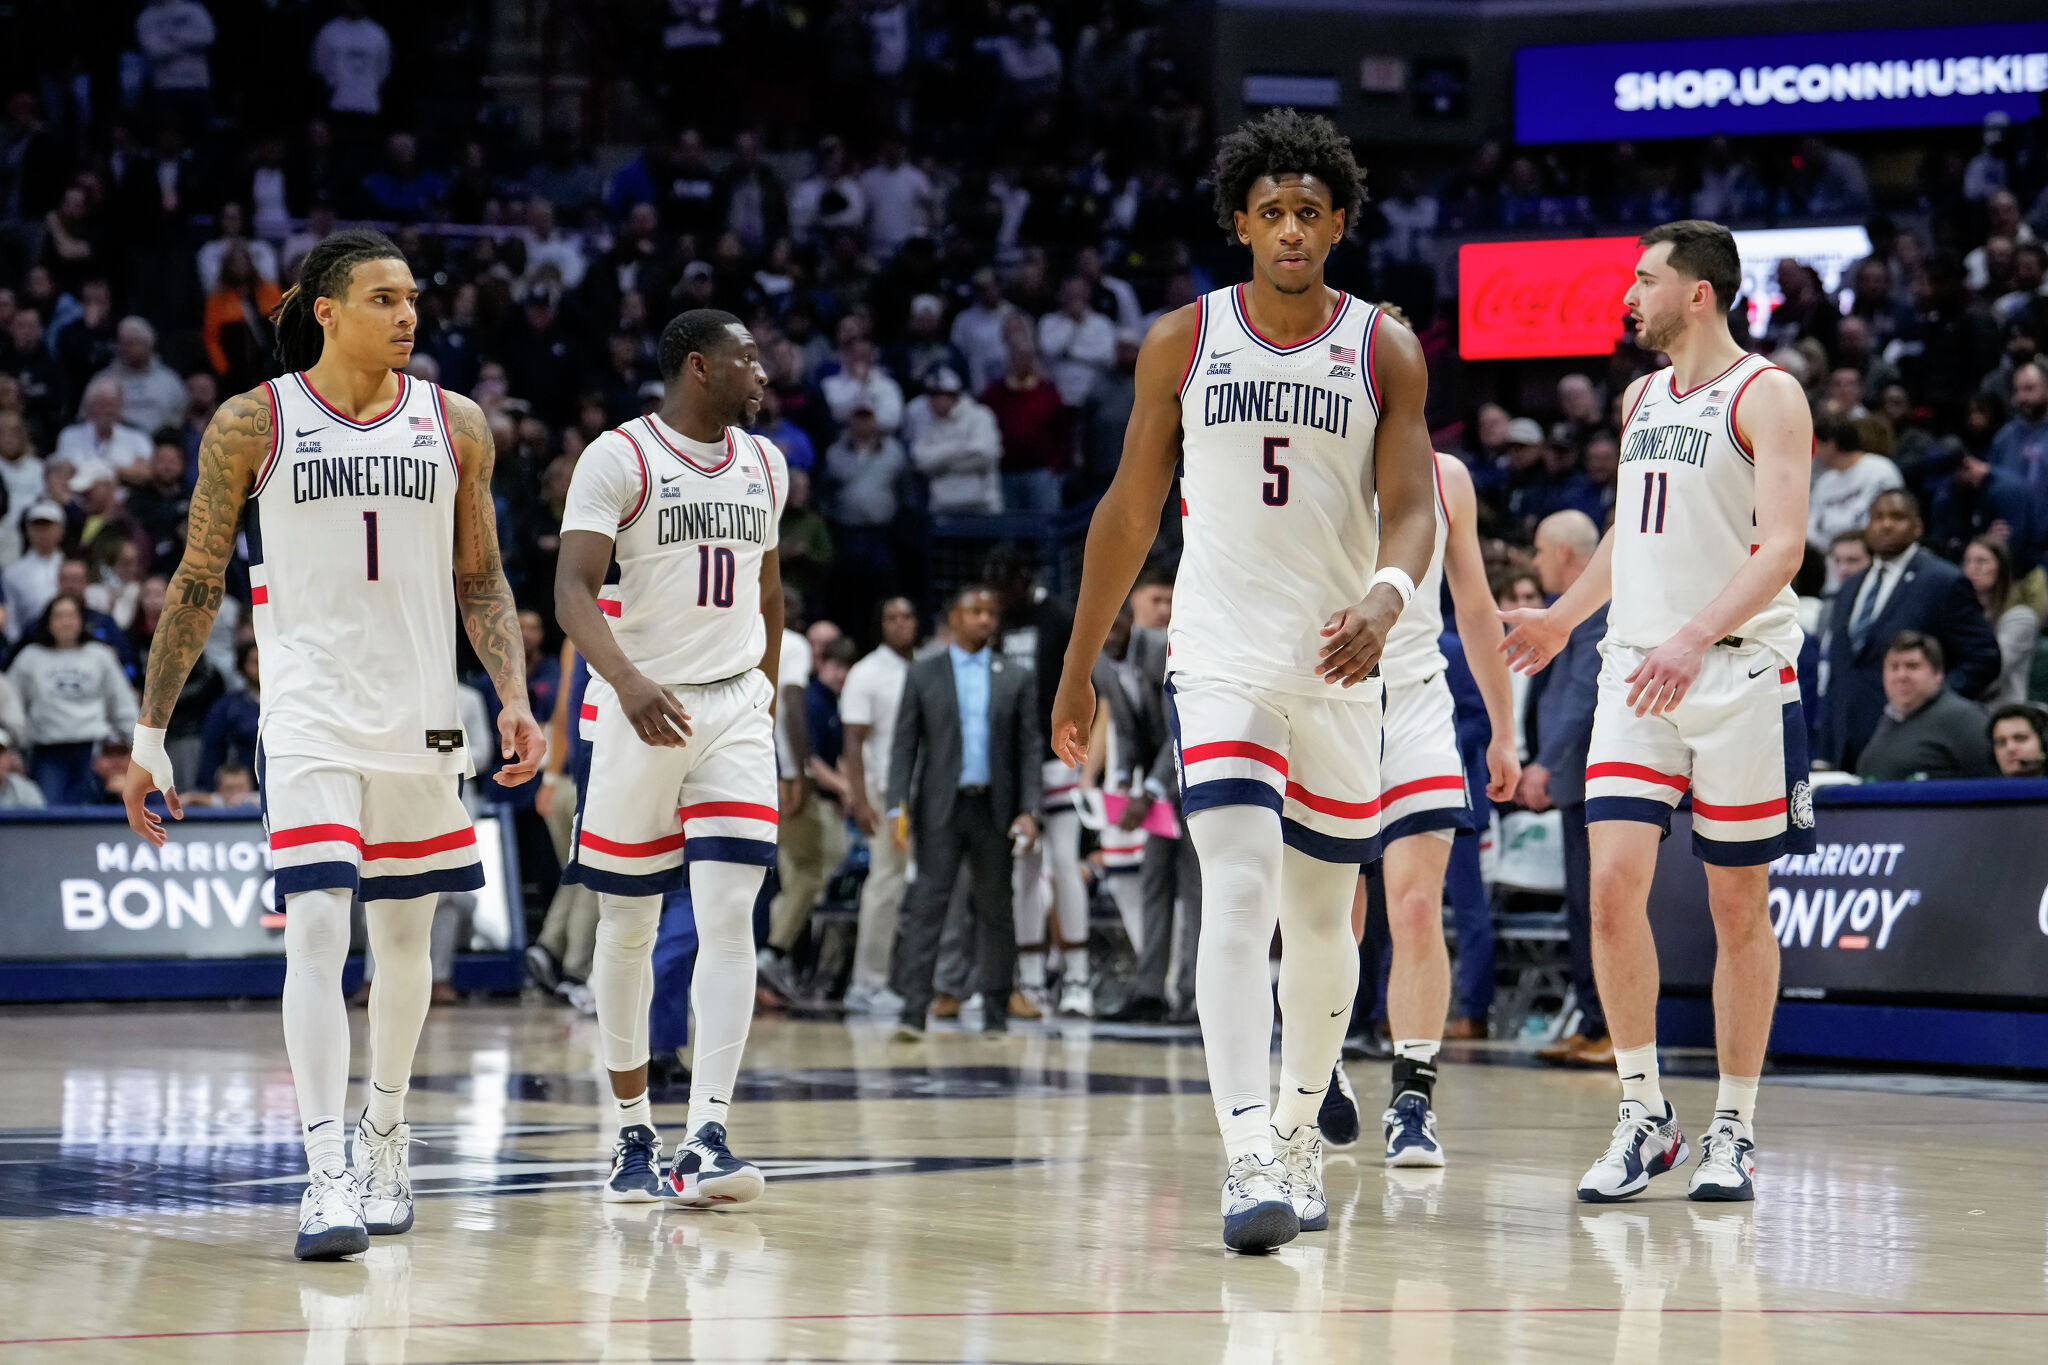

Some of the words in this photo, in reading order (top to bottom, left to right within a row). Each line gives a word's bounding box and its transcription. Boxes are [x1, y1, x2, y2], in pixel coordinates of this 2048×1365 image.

[1614, 53, 2048, 111] SHOP.UCONNHUSKIE
[1205, 381, 1352, 438] CONNECTICUT
[1262, 436, 1290, 507] 5
[1620, 425, 1712, 468] CONNECTICUT
[293, 456, 439, 504] CONNECTICUT
[1640, 472, 1667, 534] 11
[363, 511, 380, 582] 1
[658, 502, 767, 546] CONNECTICUT
[180, 577, 223, 611] 703
[697, 544, 735, 608] 10
[96, 841, 273, 872] MARRIOT
[61, 877, 277, 931] BONV
